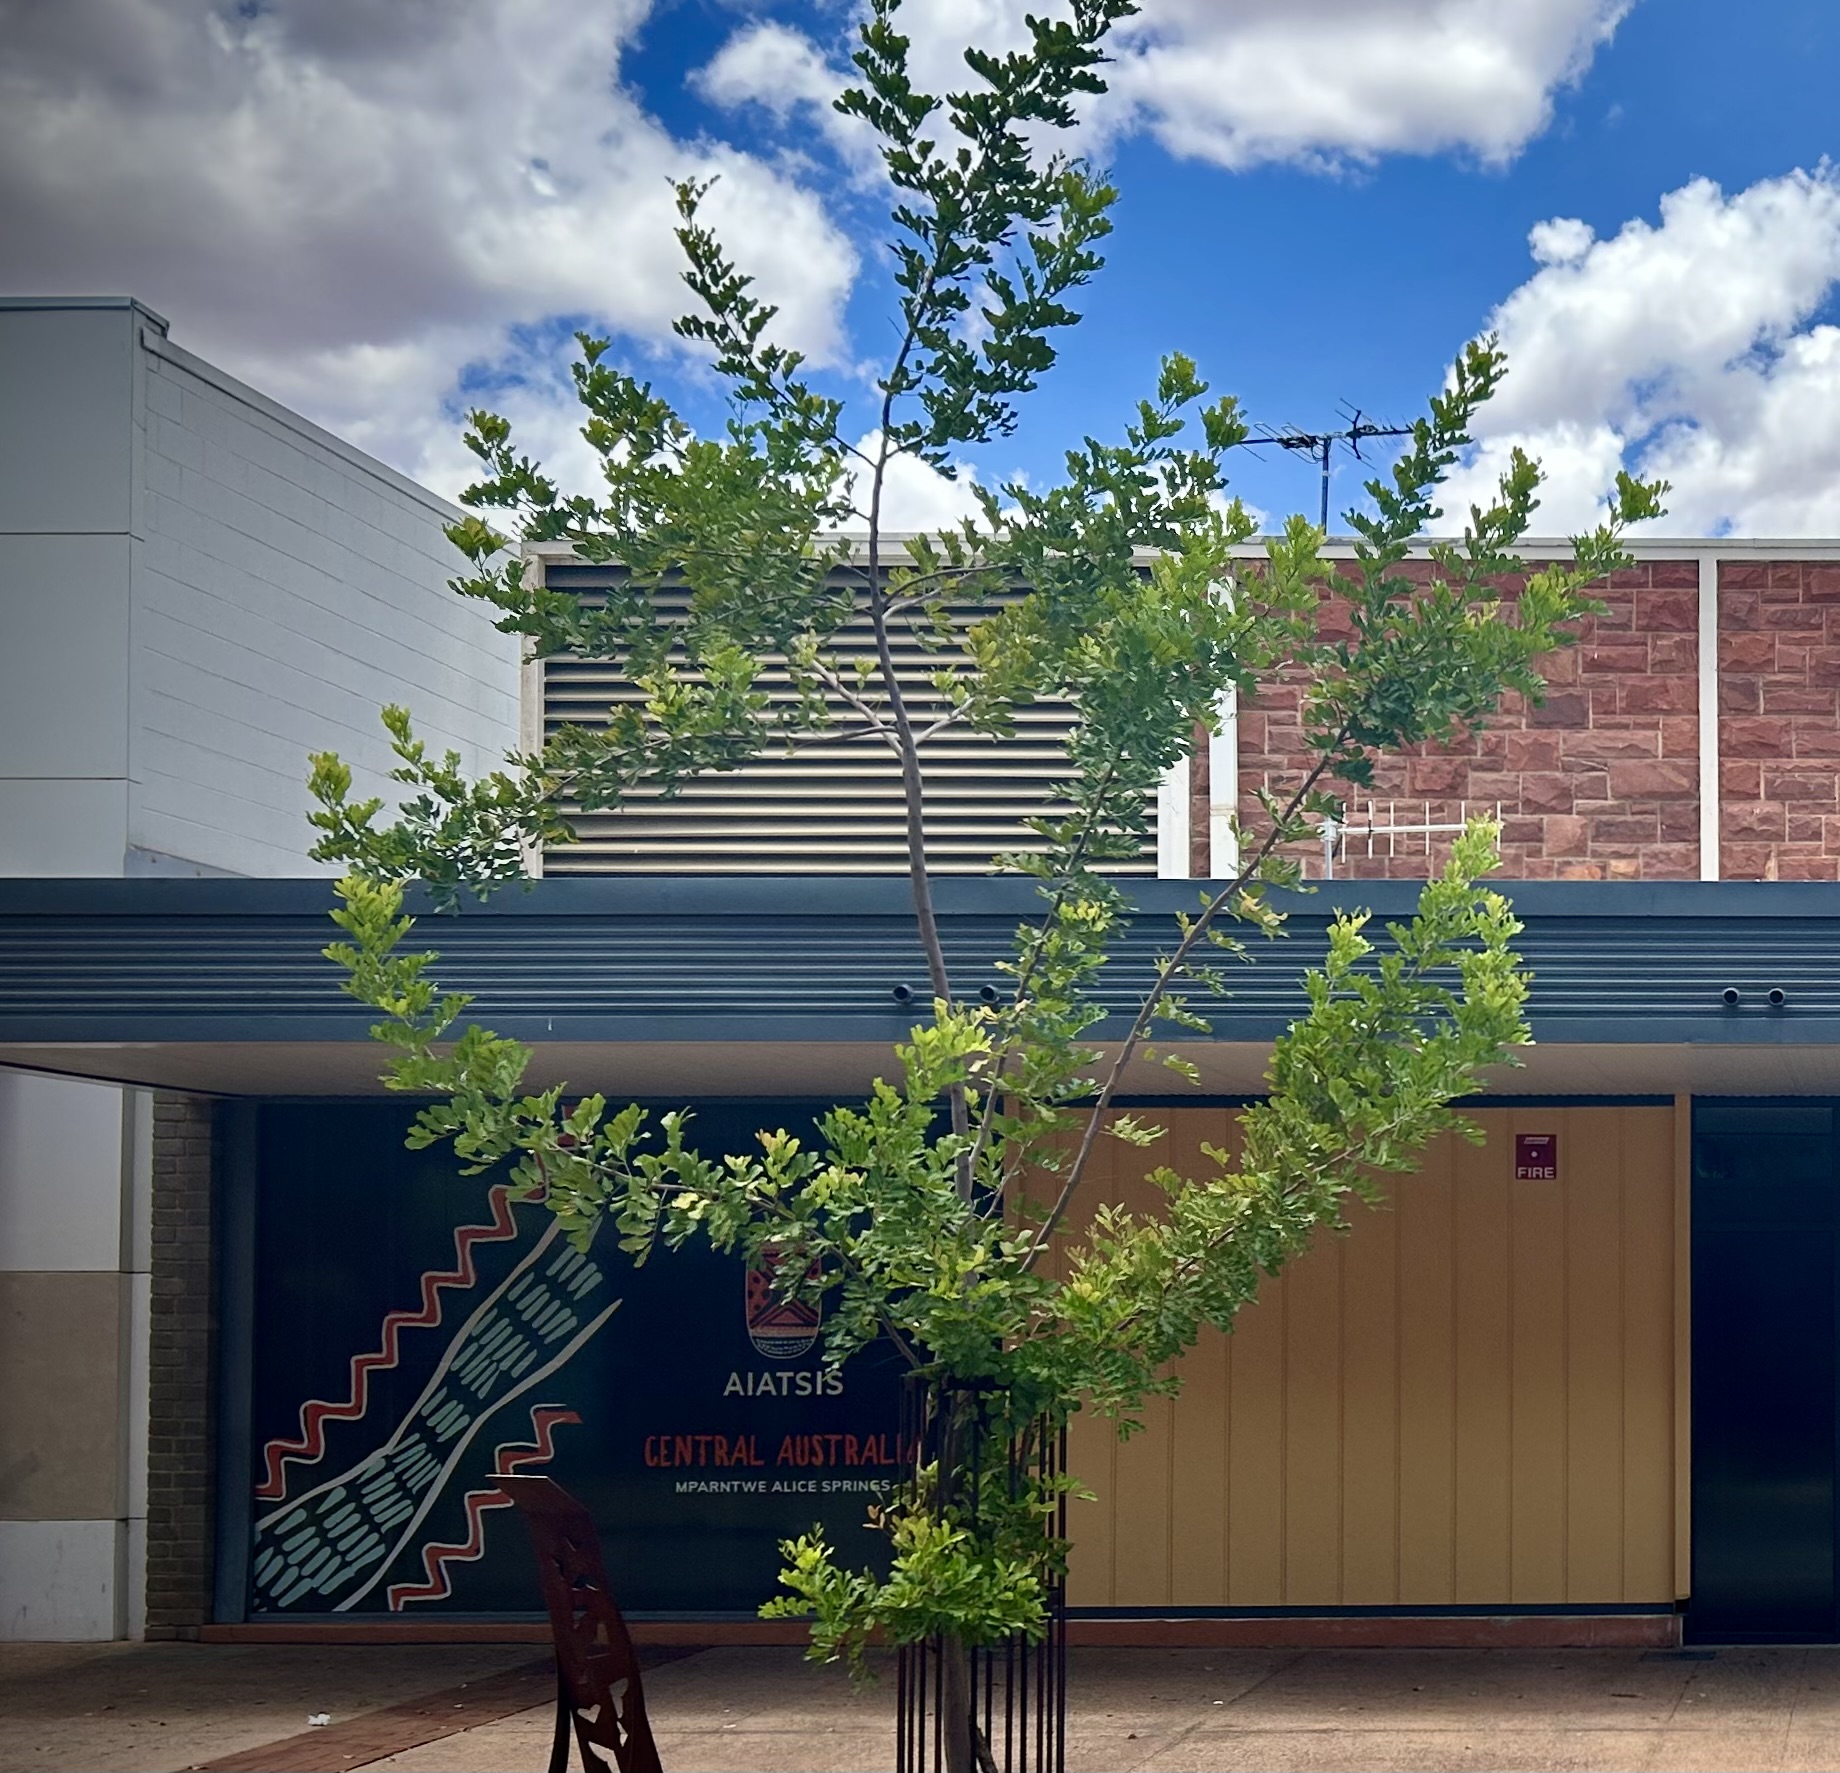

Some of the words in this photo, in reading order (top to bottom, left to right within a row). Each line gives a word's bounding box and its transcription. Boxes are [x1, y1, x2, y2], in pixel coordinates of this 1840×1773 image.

[1518, 1167, 1554, 1178] FIRE
[723, 1371, 844, 1396] AIATSIS
[645, 1434, 764, 1467] CENTRAL
[676, 1481, 766, 1493] MPARNTWE
[772, 1481, 817, 1493] ALICE
[822, 1480, 890, 1492] SPRINGS
